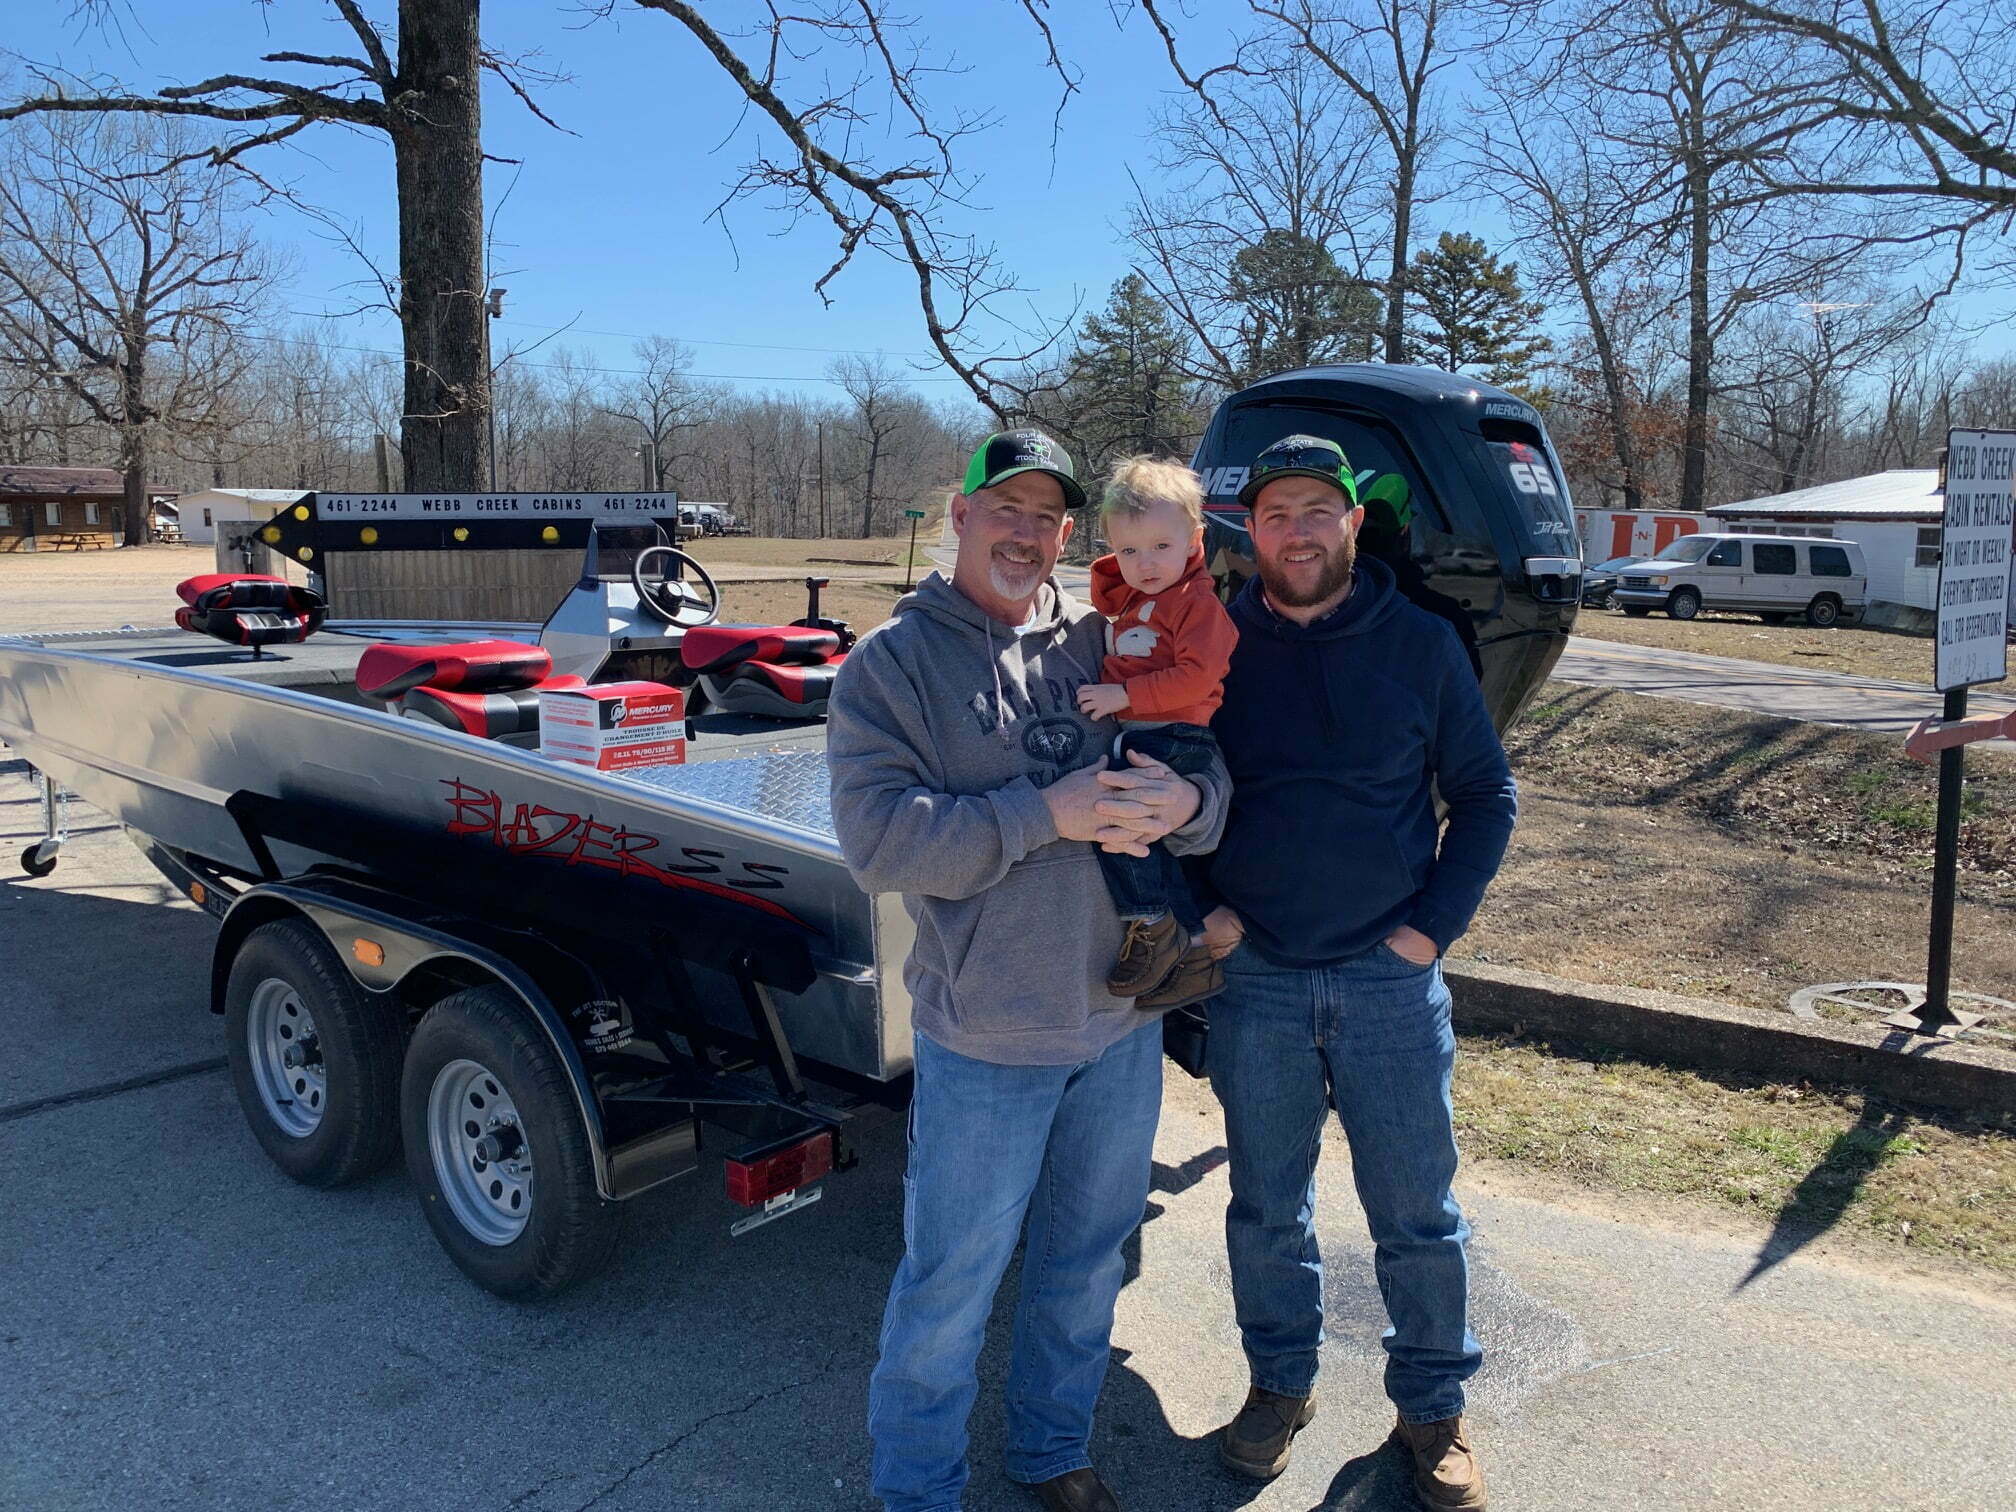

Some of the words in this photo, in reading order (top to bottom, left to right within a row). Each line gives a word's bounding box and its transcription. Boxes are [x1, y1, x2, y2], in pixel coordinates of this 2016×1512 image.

[1485, 403, 1534, 422] MERCURY
[1949, 445, 1977, 480] WEBB
[1981, 446, 2016, 480] CREEK
[1509, 462, 1556, 497] 65
[327, 499, 397, 513] 461-2244
[421, 498, 461, 511] WEBB
[476, 498, 518, 511] CREEK
[533, 497, 583, 511] CABINS
[604, 497, 667, 511] 461-2244
[1945, 493, 1970, 528] CABIN
[1973, 492, 2013, 527] RENTALS
[1981, 538, 2007, 564] WEEKLY
[628, 703, 675, 717] MERCURY
[439, 776, 672, 881] BLAZER
